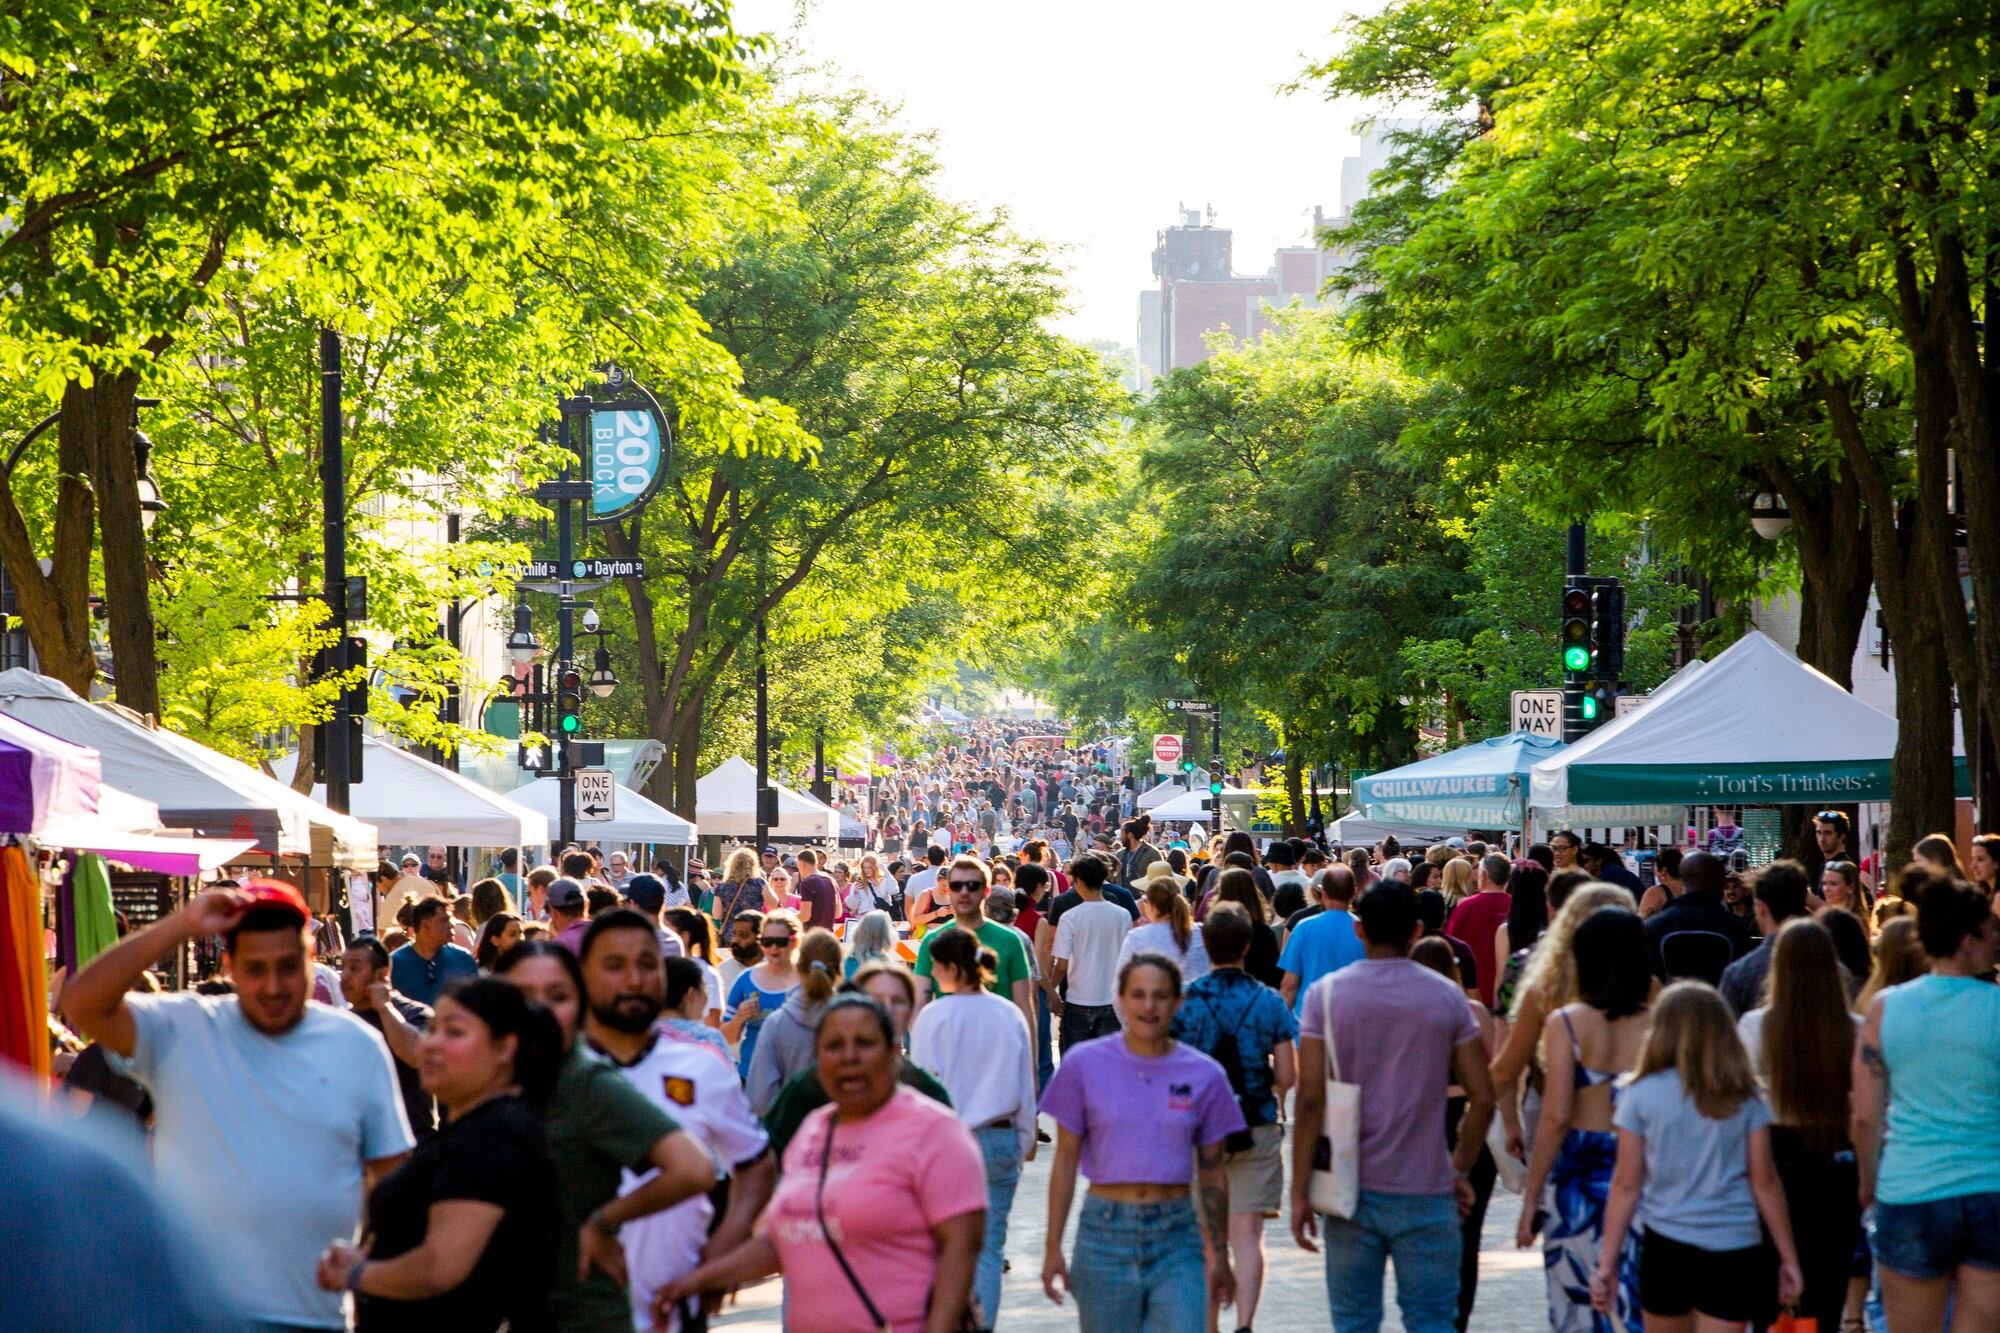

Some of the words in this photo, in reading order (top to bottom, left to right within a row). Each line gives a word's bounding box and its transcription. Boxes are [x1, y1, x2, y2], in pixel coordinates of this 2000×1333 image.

[616, 411, 651, 494] 200
[595, 428, 615, 495] BLOCK
[504, 561, 548, 577] archild
[594, 560, 633, 578] Dayton
[635, 562, 643, 570] St
[1520, 698, 1556, 714] ONE
[1519, 717, 1556, 732] WAY
[582, 776, 609, 789] ONE
[1371, 776, 1496, 798] CHILLWAUKEE
[1715, 775, 1773, 793] Tori's
[1778, 773, 1862, 792] Trinkets
[581, 790, 609, 802] WAY
